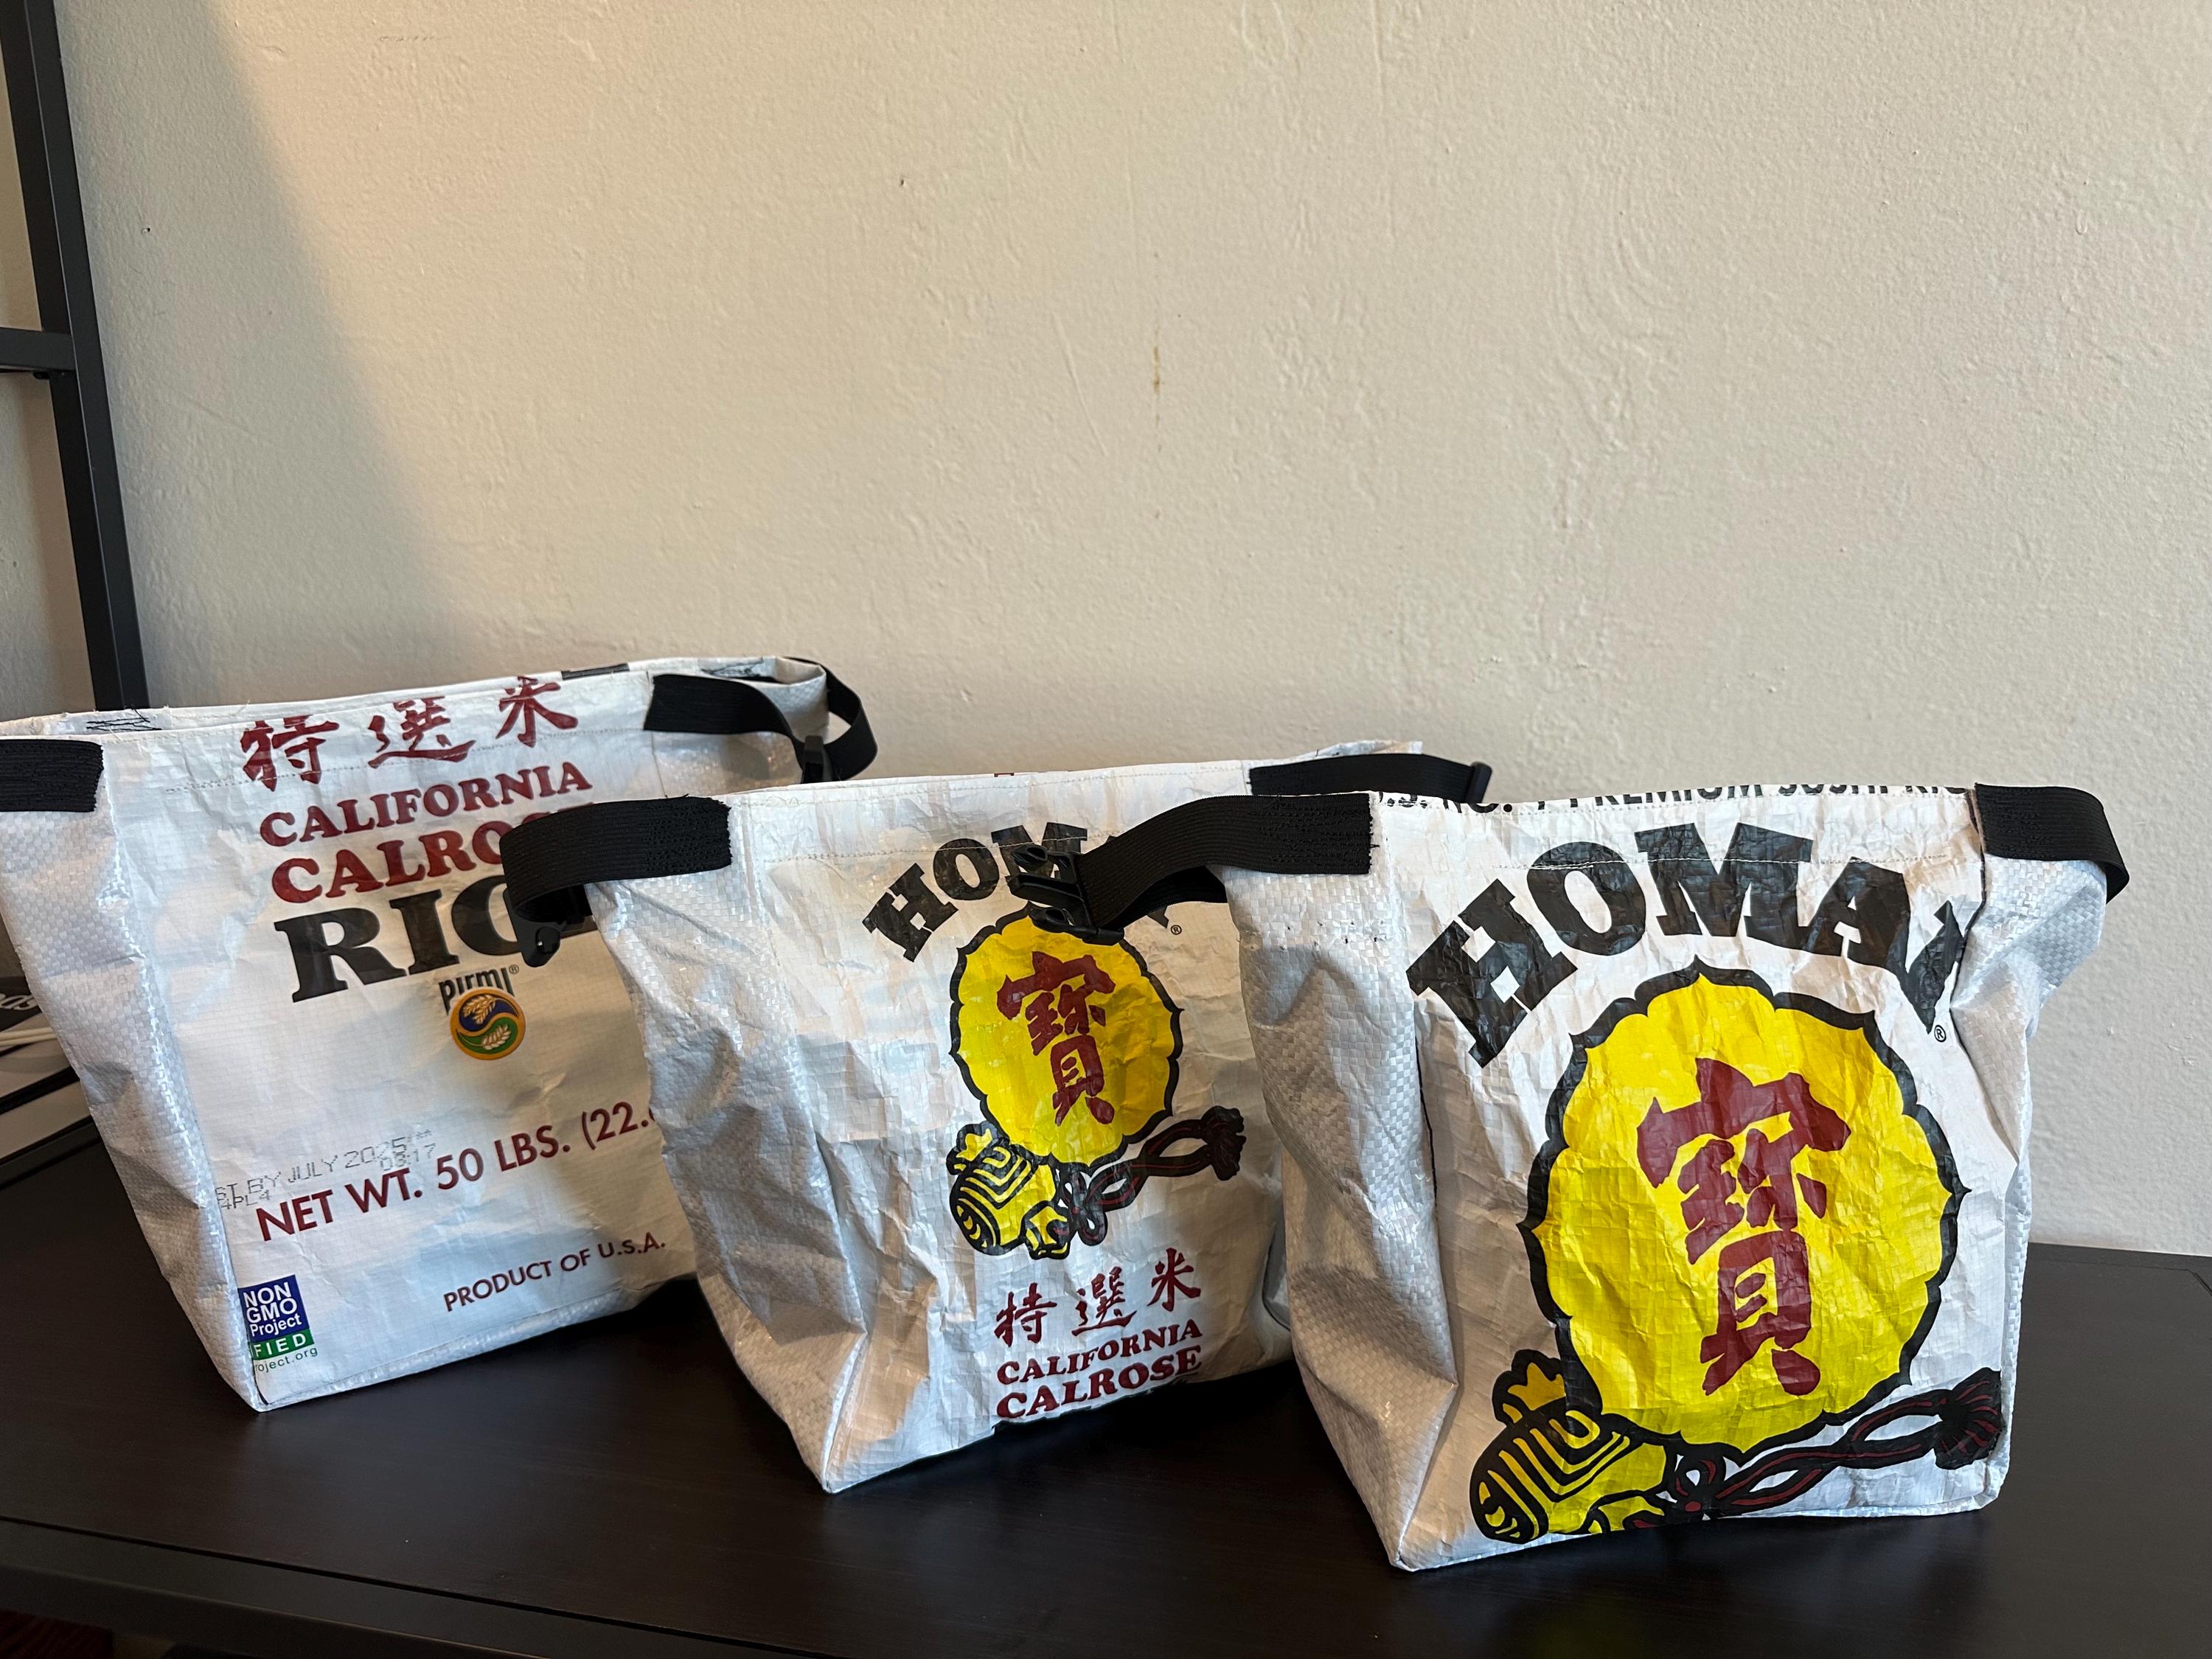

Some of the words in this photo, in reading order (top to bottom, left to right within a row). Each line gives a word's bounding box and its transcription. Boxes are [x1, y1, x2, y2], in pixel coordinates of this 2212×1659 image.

[260, 762, 593, 846] CALIFORNIA
[271, 802, 594, 903] CALRO
[274, 875, 597, 1003] RIC
[248, 1171, 282, 1194] BY
[288, 1155, 338, 1183] JULY
[256, 1189, 333, 1242] NET
[344, 1167, 423, 1214] WT.
[437, 1147, 484, 1190] 50
[494, 1124, 571, 1172] LBS.
[582, 1102, 655, 1151] (22.
[243, 1281, 292, 1308] NON
[443, 1260, 552, 1312] PRODUCT
[560, 1248, 591, 1272] OF
[597, 1232, 667, 1259] U.S.A.
[246, 1298, 297, 1324] GMO
[250, 1313, 302, 1337] Project
[996, 1345, 1203, 1419] CALROSE
[997, 1319, 1203, 1385] CALIFORNIA
